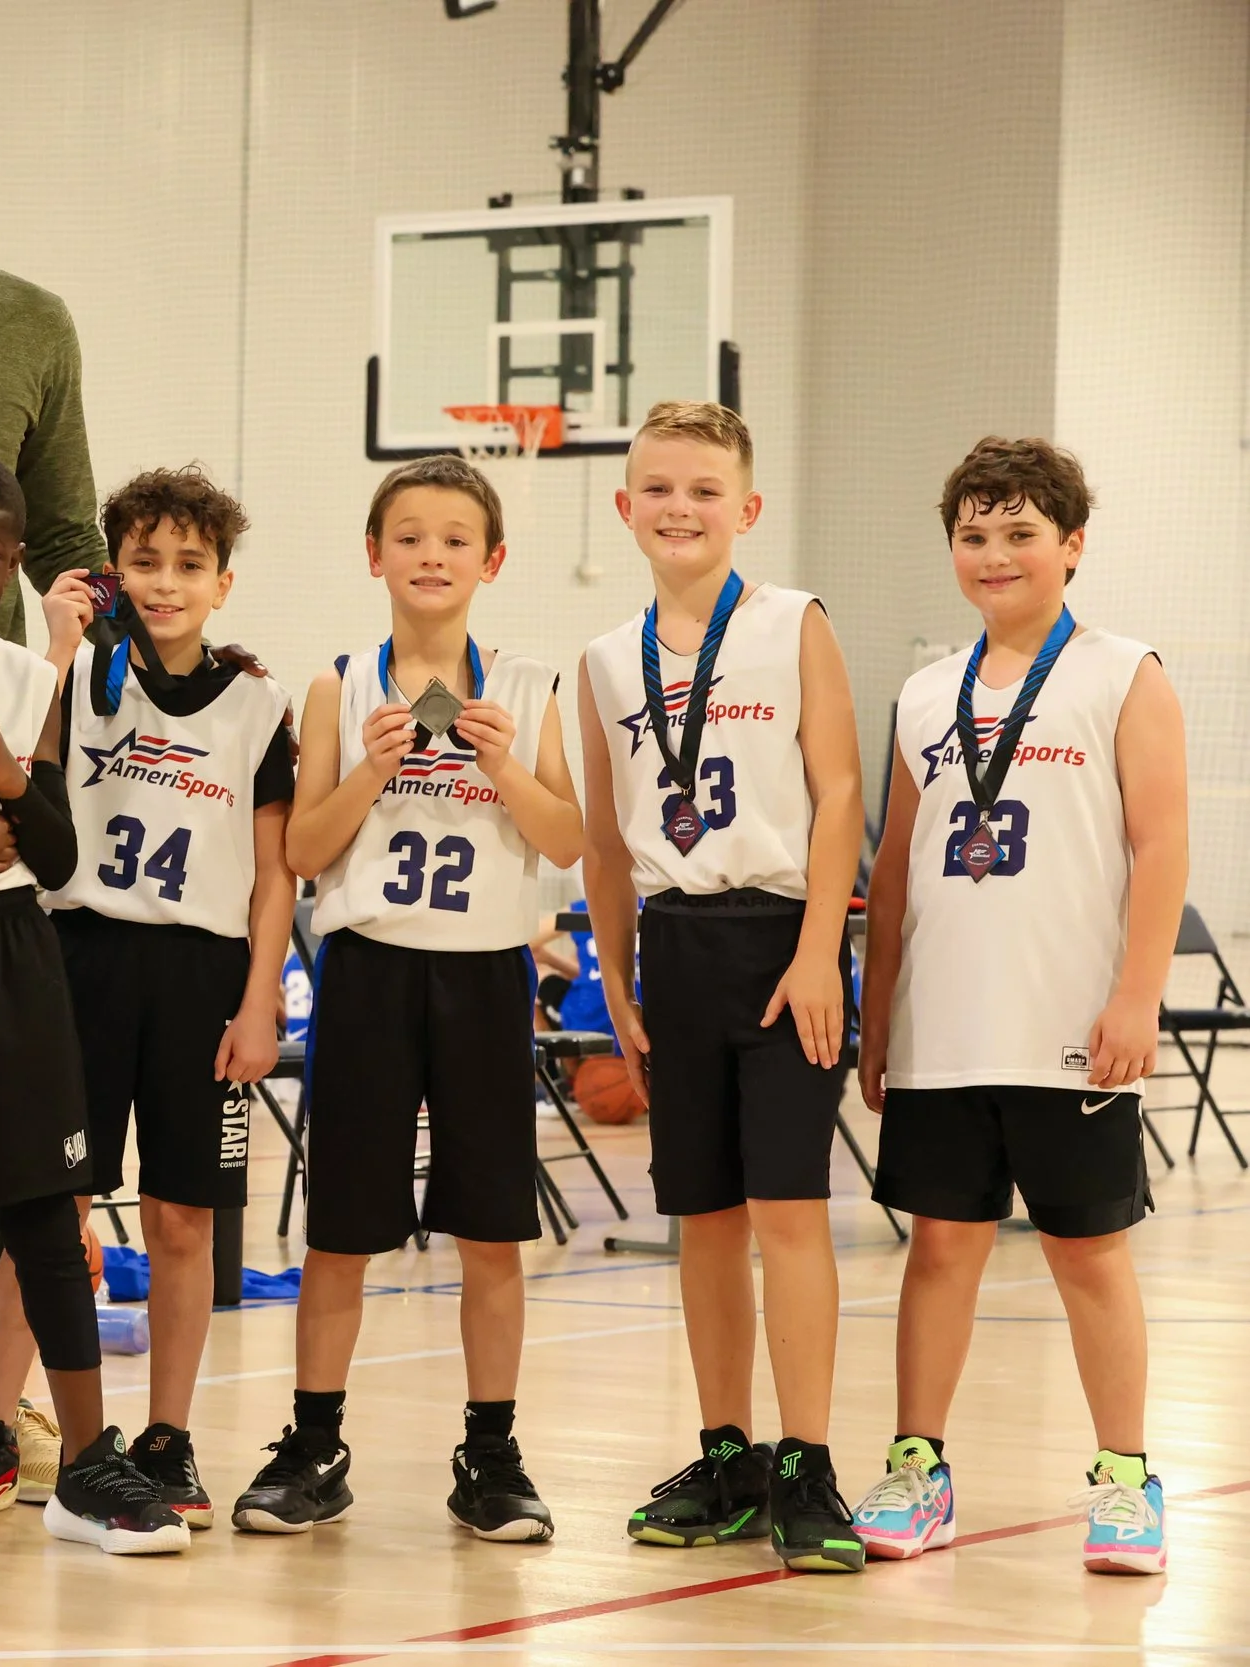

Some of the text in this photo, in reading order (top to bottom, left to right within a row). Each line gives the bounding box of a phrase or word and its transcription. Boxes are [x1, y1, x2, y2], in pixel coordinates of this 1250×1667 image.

[382, 778, 501, 806] AmeriSpor
[97, 814, 192, 902] 34
[383, 831, 475, 912] 32
[942, 799, 1030, 877] 23
[220, 1098, 249, 1160] STAR
